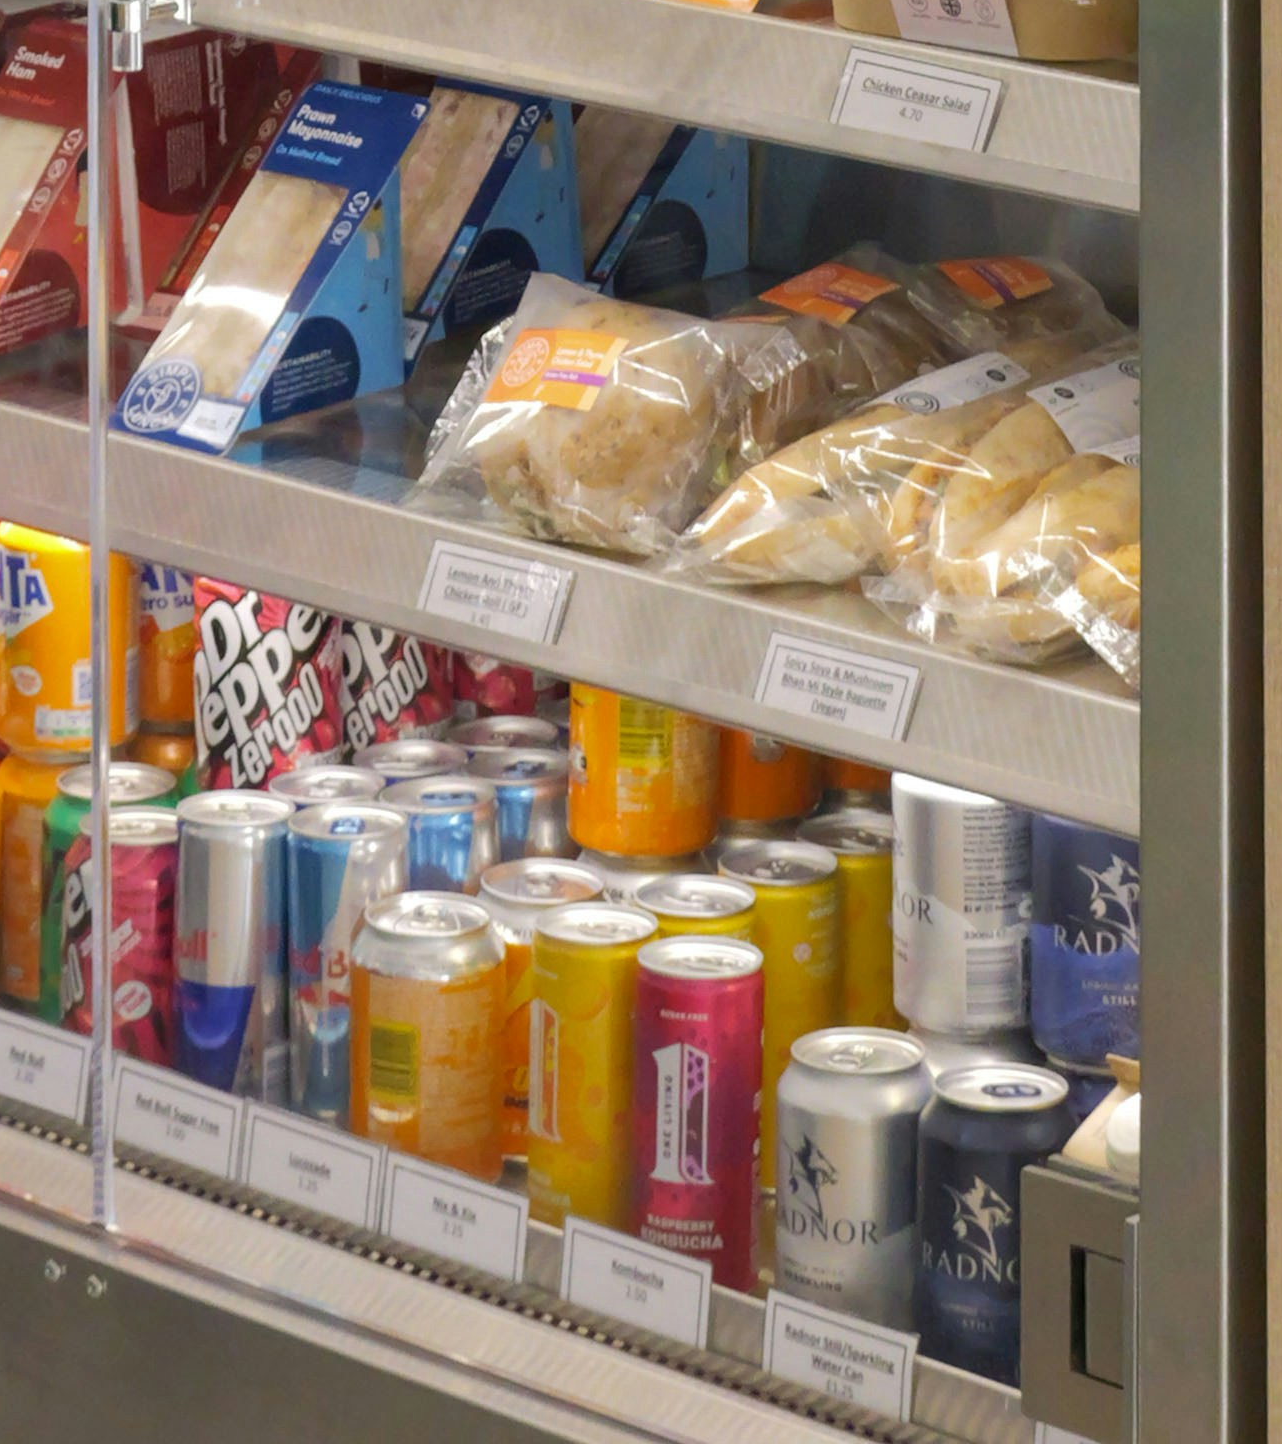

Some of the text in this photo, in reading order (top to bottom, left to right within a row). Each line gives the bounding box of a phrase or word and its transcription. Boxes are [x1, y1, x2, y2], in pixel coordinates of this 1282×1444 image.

[14, 45, 66, 70] Smoked
[5, 60, 38, 82] Ham
[861, 76, 972, 115] Chicken Ceasar Salad
[295, 103, 338, 126] Prawn
[898, 107, 923, 123] 4.70
[286, 120, 364, 150] Mayonnaise
[145, 361, 197, 394] SIMPLY
[447, 564, 481, 585] Lemon
[443, 585, 482, 607] Chicken
[200, 589, 263, 686] Dr
[820, 681, 845, 701] Style
[832, 665, 842, 678] &
[842, 668, 894, 694] Mushroom
[810, 698, 847, 722] (Vegan)
[646, 1211, 716, 1235] RASPBERRY
[639, 1225, 725, 1252] KOMBUCHA
[611, 1257, 666, 1290] Kombucha
[783, 1321, 821, 1351] Radnor
[811, 1352, 865, 1384] Water Can
